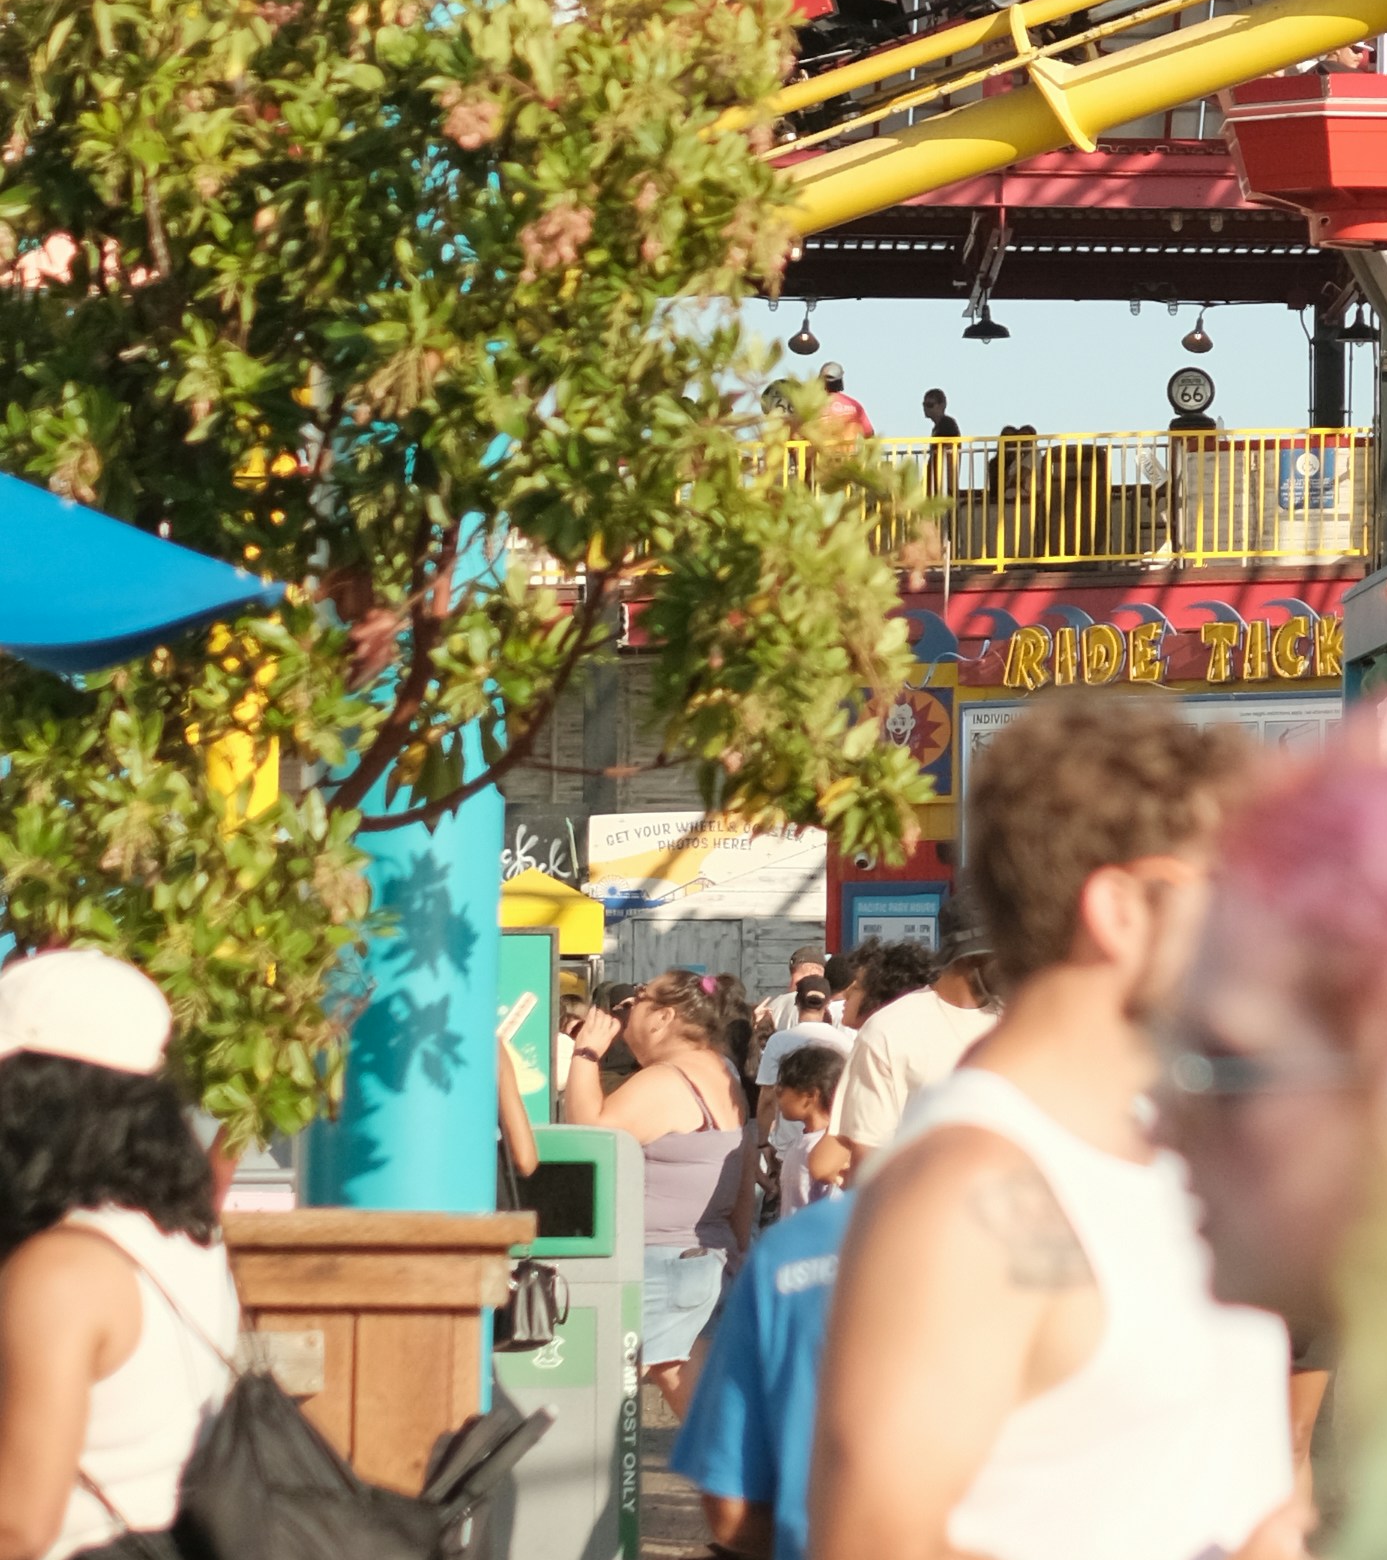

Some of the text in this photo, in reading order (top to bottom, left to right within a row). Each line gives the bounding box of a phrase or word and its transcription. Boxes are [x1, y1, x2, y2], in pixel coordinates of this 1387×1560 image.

[1181, 386, 1203, 402] 66
[1003, 621, 1167, 691] RIDE
[606, 830, 631, 847] GET
[635, 823, 672, 839] YOUR
[676, 820, 725, 834] WHEEL
[658, 838, 753, 853] PHOTOS HERE!
[621, 1331, 639, 1513] COMPOST ONLY
